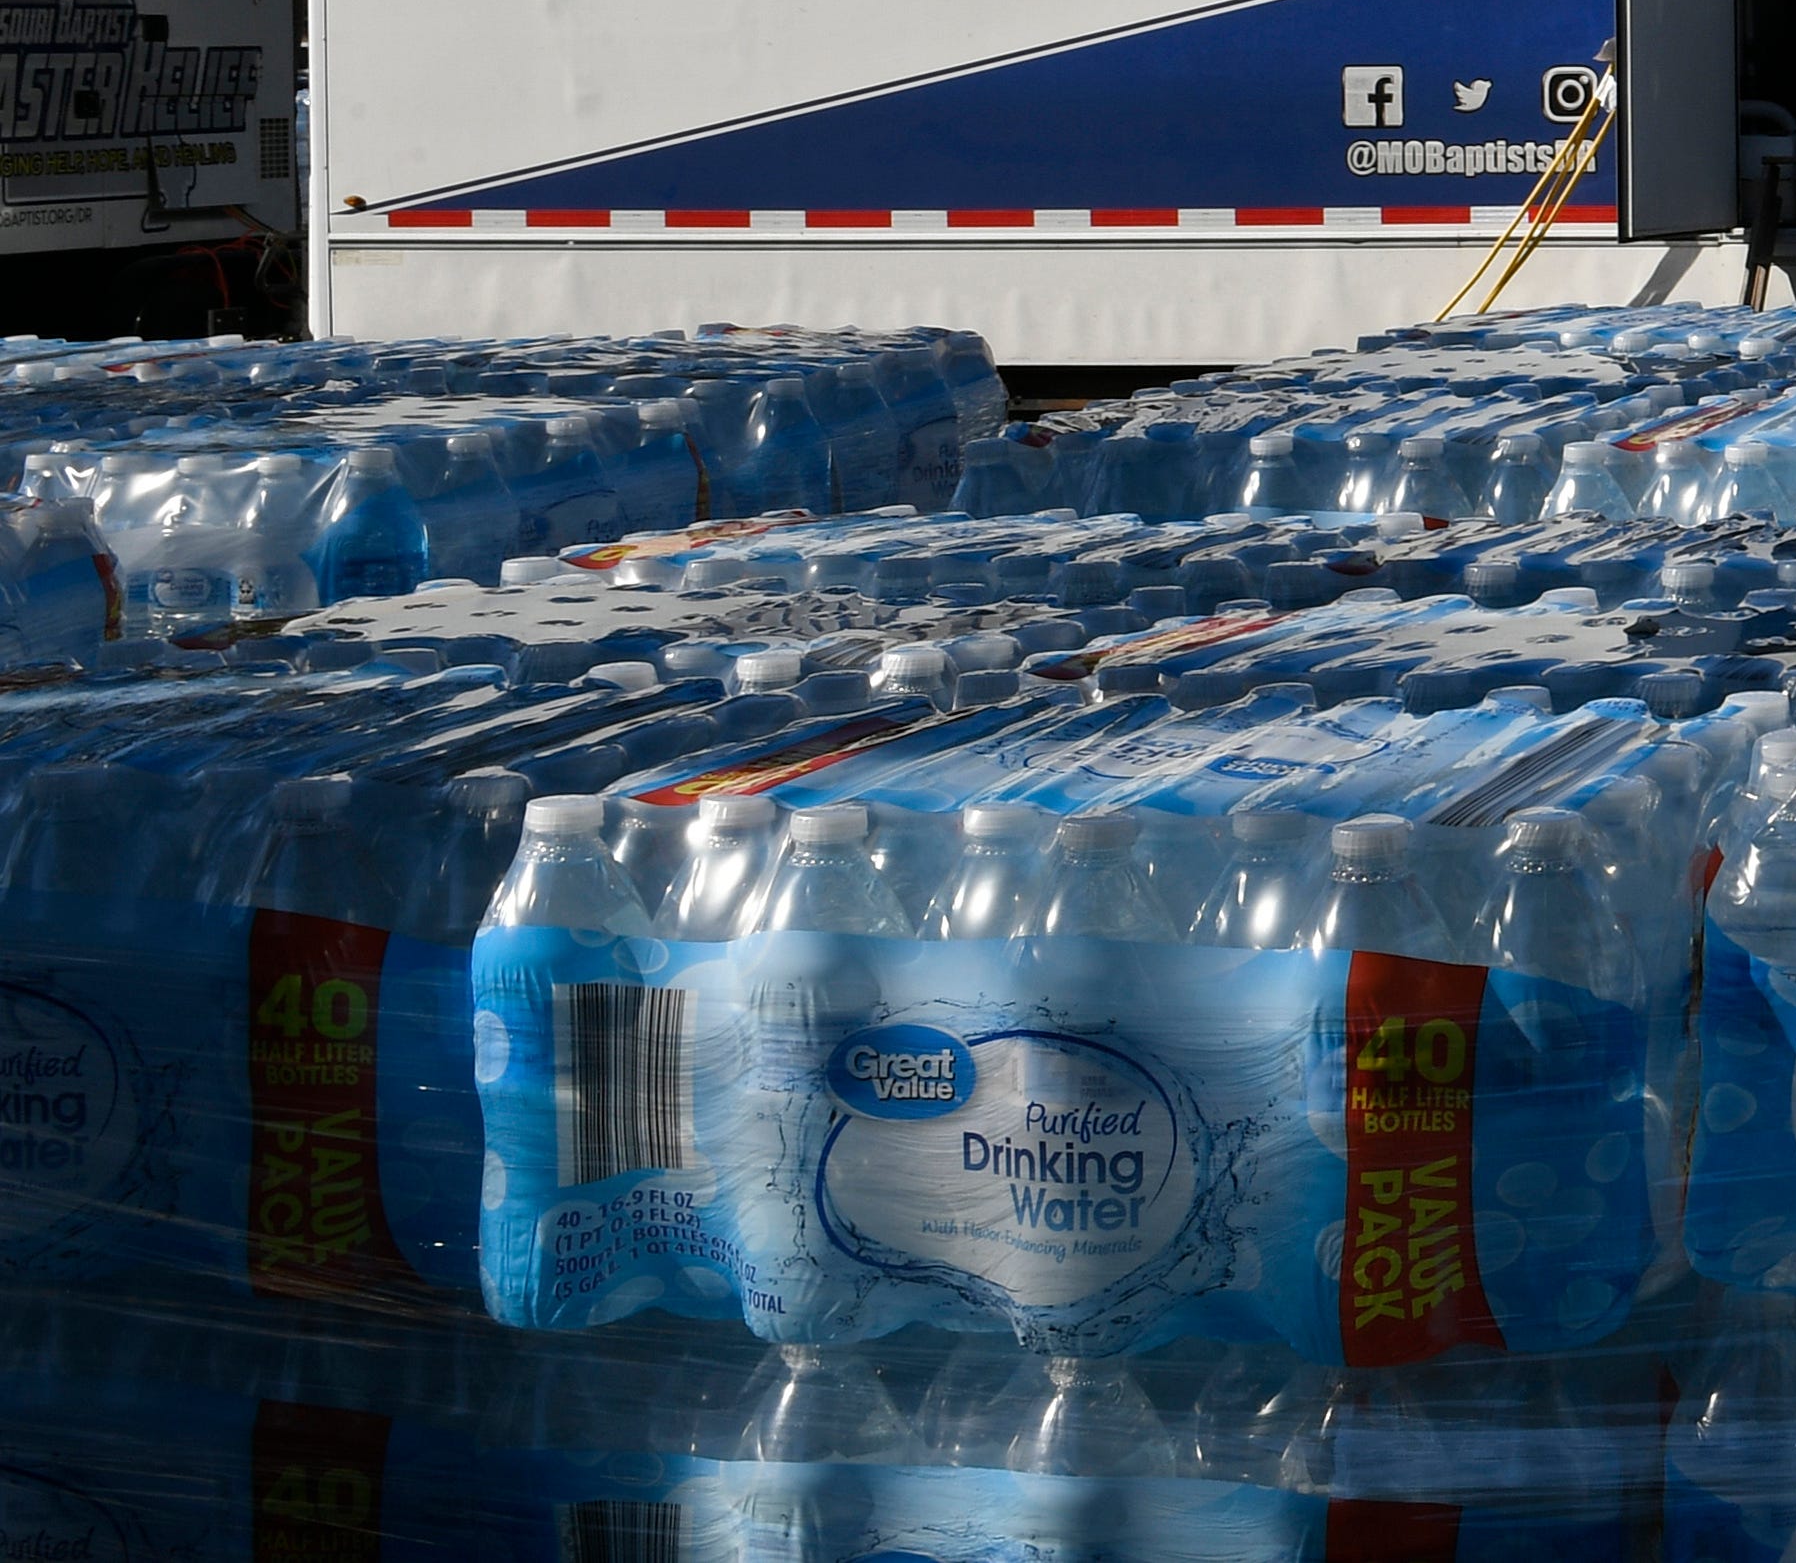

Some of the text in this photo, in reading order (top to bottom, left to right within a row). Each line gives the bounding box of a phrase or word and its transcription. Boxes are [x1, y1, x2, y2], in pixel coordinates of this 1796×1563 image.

[257, 973, 368, 1040] 40
[252, 1042, 374, 1065] HALF LITER
[846, 1044, 956, 1081] Great
[1355, 1014, 1467, 1085] 40
[265, 1064, 359, 1086] BOTTLES
[873, 1078, 956, 1100] Value
[1351, 1086, 1470, 1110] HALF LITER
[1025, 1100, 1146, 1143] Purified
[1363, 1109, 1456, 1133] BOTTLES
[963, 1131, 1144, 1195] Drinking
[259, 1121, 306, 1270] PACK
[310, 1109, 372, 1267] VALUE
[557, 1211, 581, 1228] 40
[650, 1189, 669, 1205] FL
[673, 1191, 694, 1209] OZ
[1010, 1183, 1146, 1232] Water
[579, 1225, 603, 1250] PT
[611, 1209, 644, 1233] 0.9
[650, 1208, 669, 1223] FL
[673, 1211, 701, 1230] OZ)
[632, 1225, 708, 1244] BOTTLES
[1353, 1169, 1407, 1331] PACK
[1408, 1155, 1466, 1320] VALUE
[646, 1241, 669, 1255] QT
[748, 1289, 787, 1315] TOTAL
[261, 1462, 372, 1526] 40
